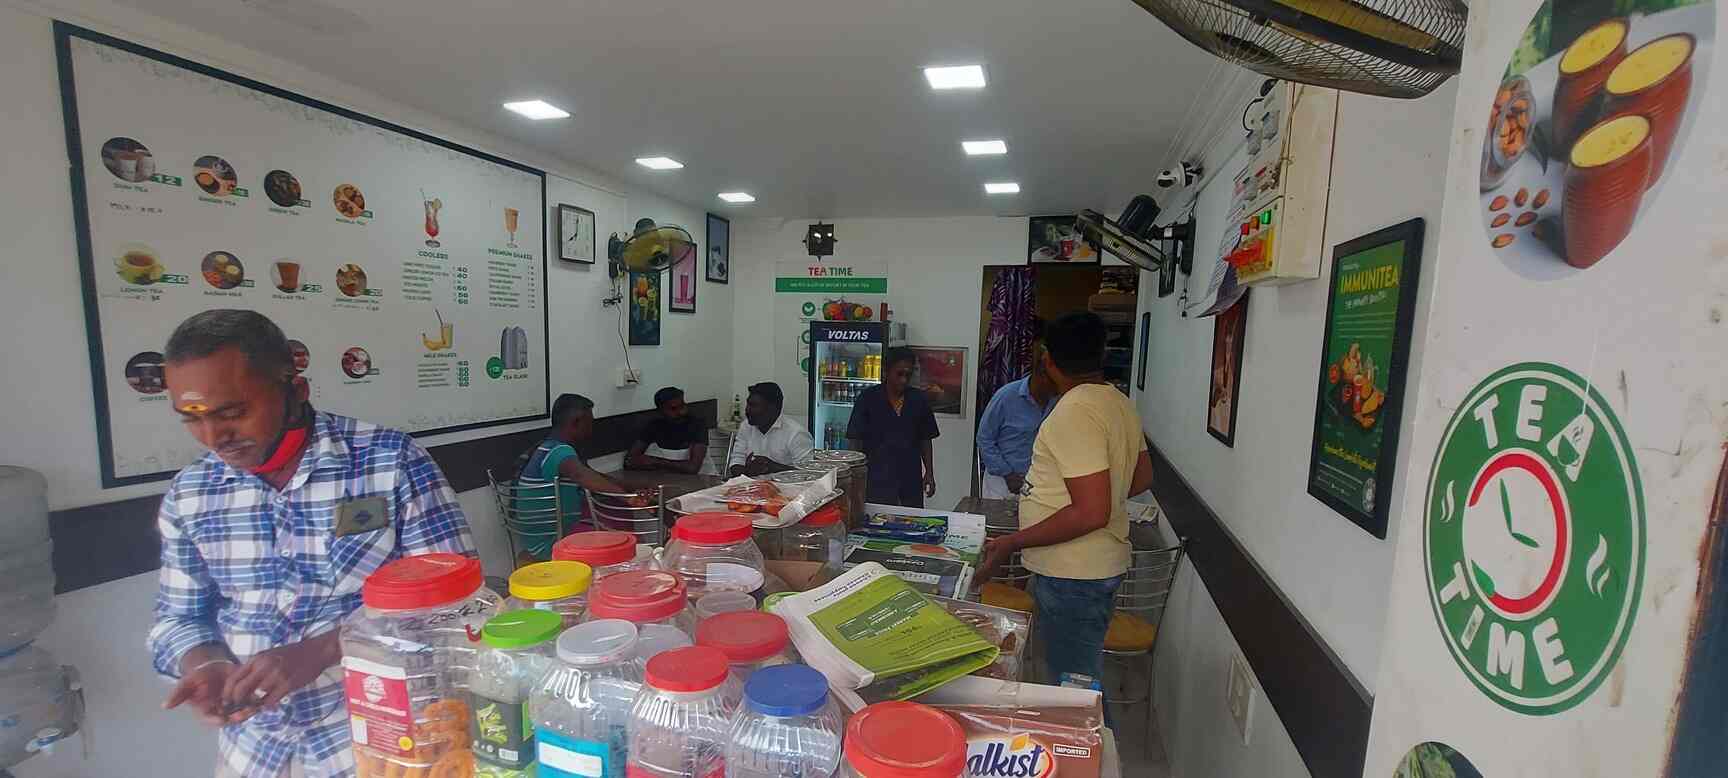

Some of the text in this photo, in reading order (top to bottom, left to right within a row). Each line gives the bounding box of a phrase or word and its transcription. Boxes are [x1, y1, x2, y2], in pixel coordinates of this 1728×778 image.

[808, 267, 854, 277] TEA TIME
[1340, 264, 1399, 294] IMMUNITEA
[826, 330, 870, 341] VOLTAS
[1474, 385, 1595, 482] TEA
[1440, 561, 1575, 690] TIME
[965, 742, 1045, 778] alkist
[1055, 746, 1088, 756] IMPORTED
